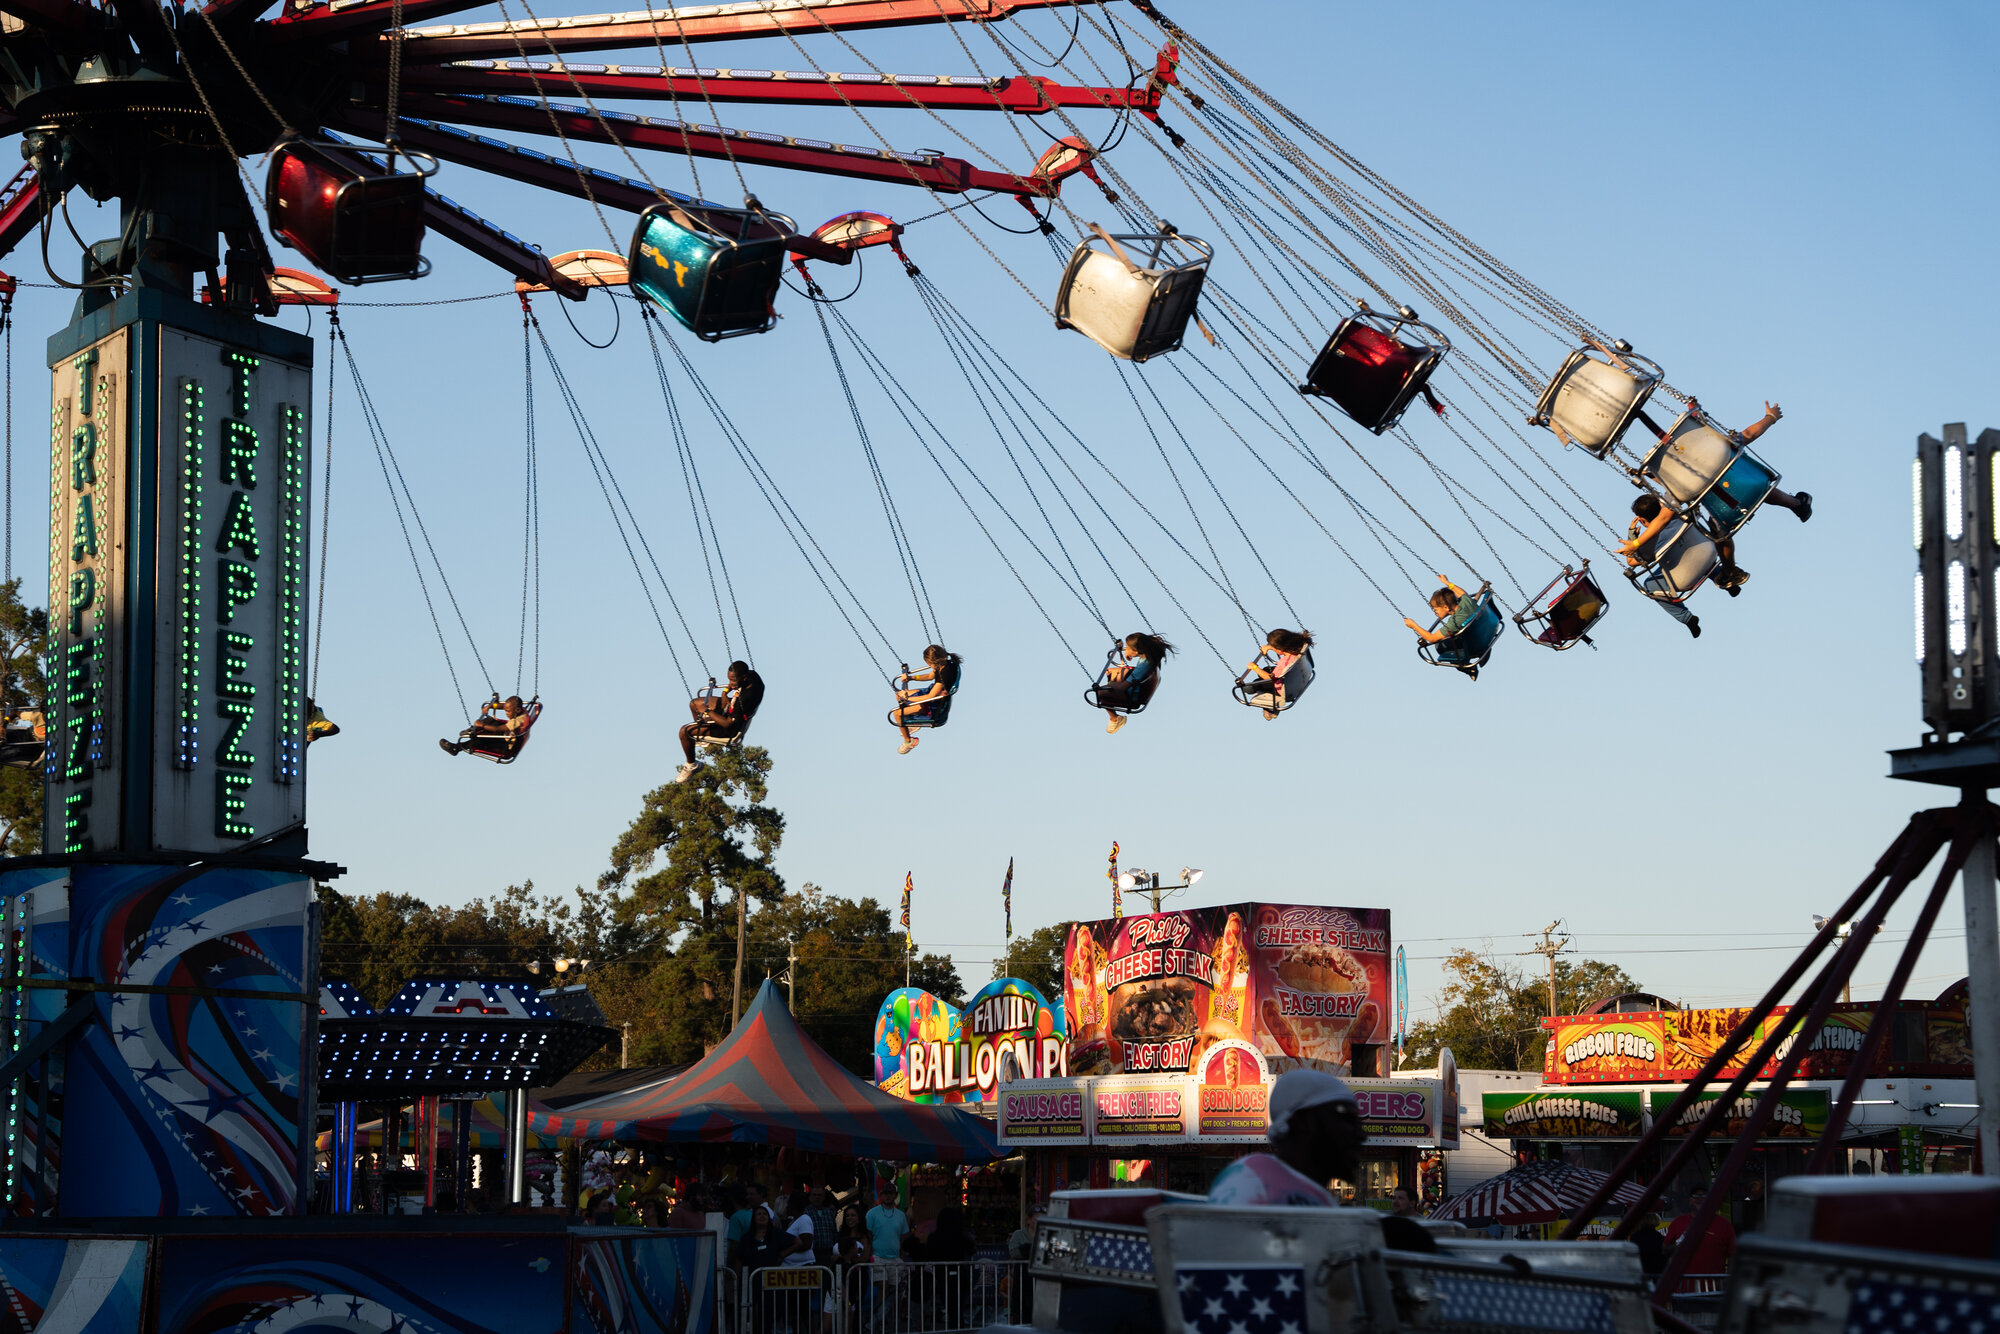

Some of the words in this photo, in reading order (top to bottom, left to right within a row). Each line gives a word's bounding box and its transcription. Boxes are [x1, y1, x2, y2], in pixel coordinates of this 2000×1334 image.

[65, 349, 99, 855] TRAPEZE
[215, 349, 261, 839] TRAPEZE
[1129, 915, 1190, 949] Philly
[1282, 909, 1359, 931] Philly
[1256, 926, 1323, 946] CHEESE
[1327, 929, 1385, 952] STEAK
[1106, 948, 1163, 991] CHEESE
[1164, 948, 1214, 987] STEAK
[973, 995, 1037, 1035] FAMILY
[1274, 988, 1367, 1017] FACTORY
[1565, 1031, 1615, 1065] RIBBON
[1616, 1032, 1655, 1062] FRIES
[1823, 1026, 1866, 1052] TENDE
[909, 1037, 1036, 1095] BALLOON
[1122, 1036, 1195, 1072] FACTORY
[1006, 1092, 1082, 1121] SAUSAGE
[1096, 1091, 1145, 1119] FRENCH
[1146, 1089, 1182, 1118] FRIES
[1201, 1089, 1233, 1112] CORN
[1234, 1089, 1267, 1112] DOGS
[1353, 1090, 1425, 1120] GERS
[1503, 1101, 1537, 1125] CHILI
[1535, 1097, 1581, 1119] CHEESE
[1582, 1100, 1618, 1124] FRIES
[1022, 1126, 1040, 1134] SAUSAGE
[1063, 1125, 1081, 1133] SAUSAGE
[1099, 1124, 1112, 1132] CHEESE
[1112, 1124, 1122, 1132] FRIES
[1135, 1124, 1148, 1132] CHEESE
[1389, 1125, 1406, 1133] CORN
[1407, 1125, 1425, 1134] DOGS
[767, 1270, 818, 1286] ENTER
